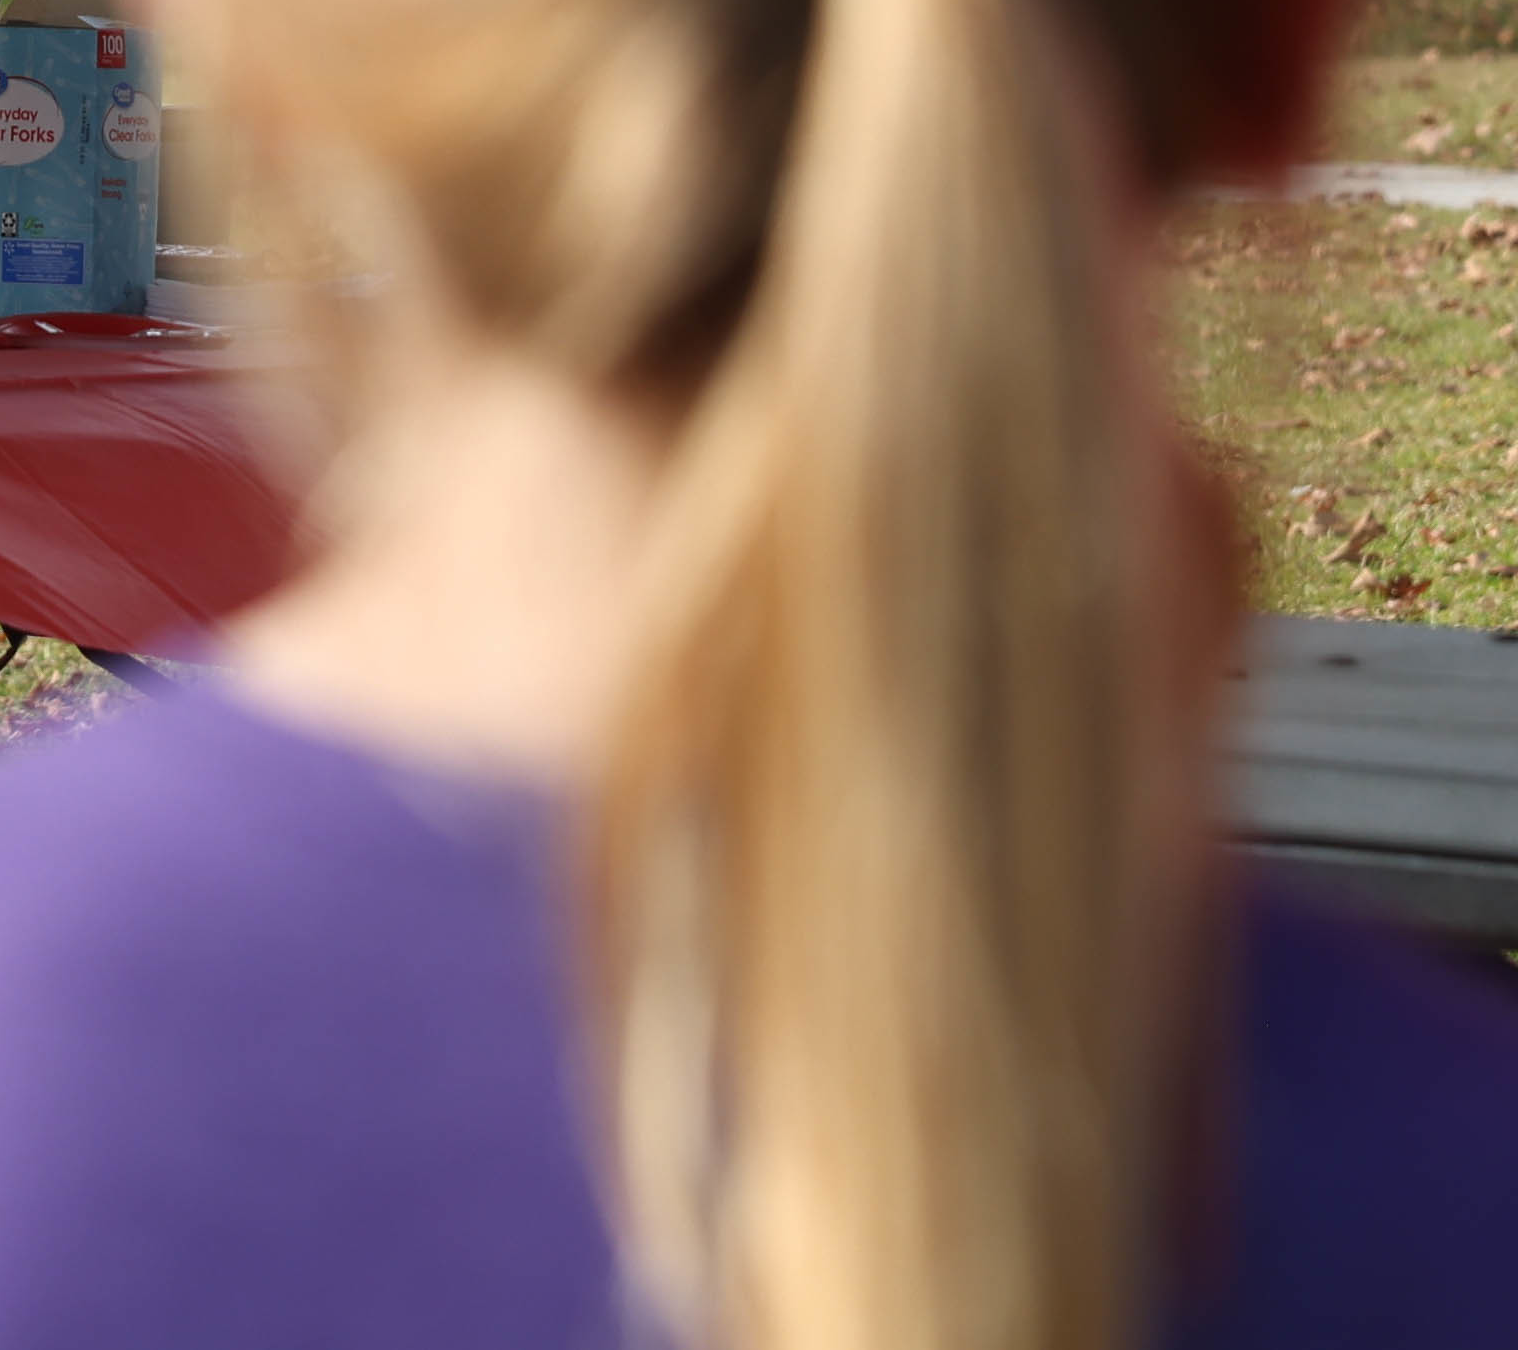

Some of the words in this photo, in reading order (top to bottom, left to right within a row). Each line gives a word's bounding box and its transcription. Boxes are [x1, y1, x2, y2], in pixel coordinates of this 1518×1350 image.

[101, 35, 124, 54] 100
[10, 126, 55, 143] Forks
[108, 128, 135, 142] Clear
